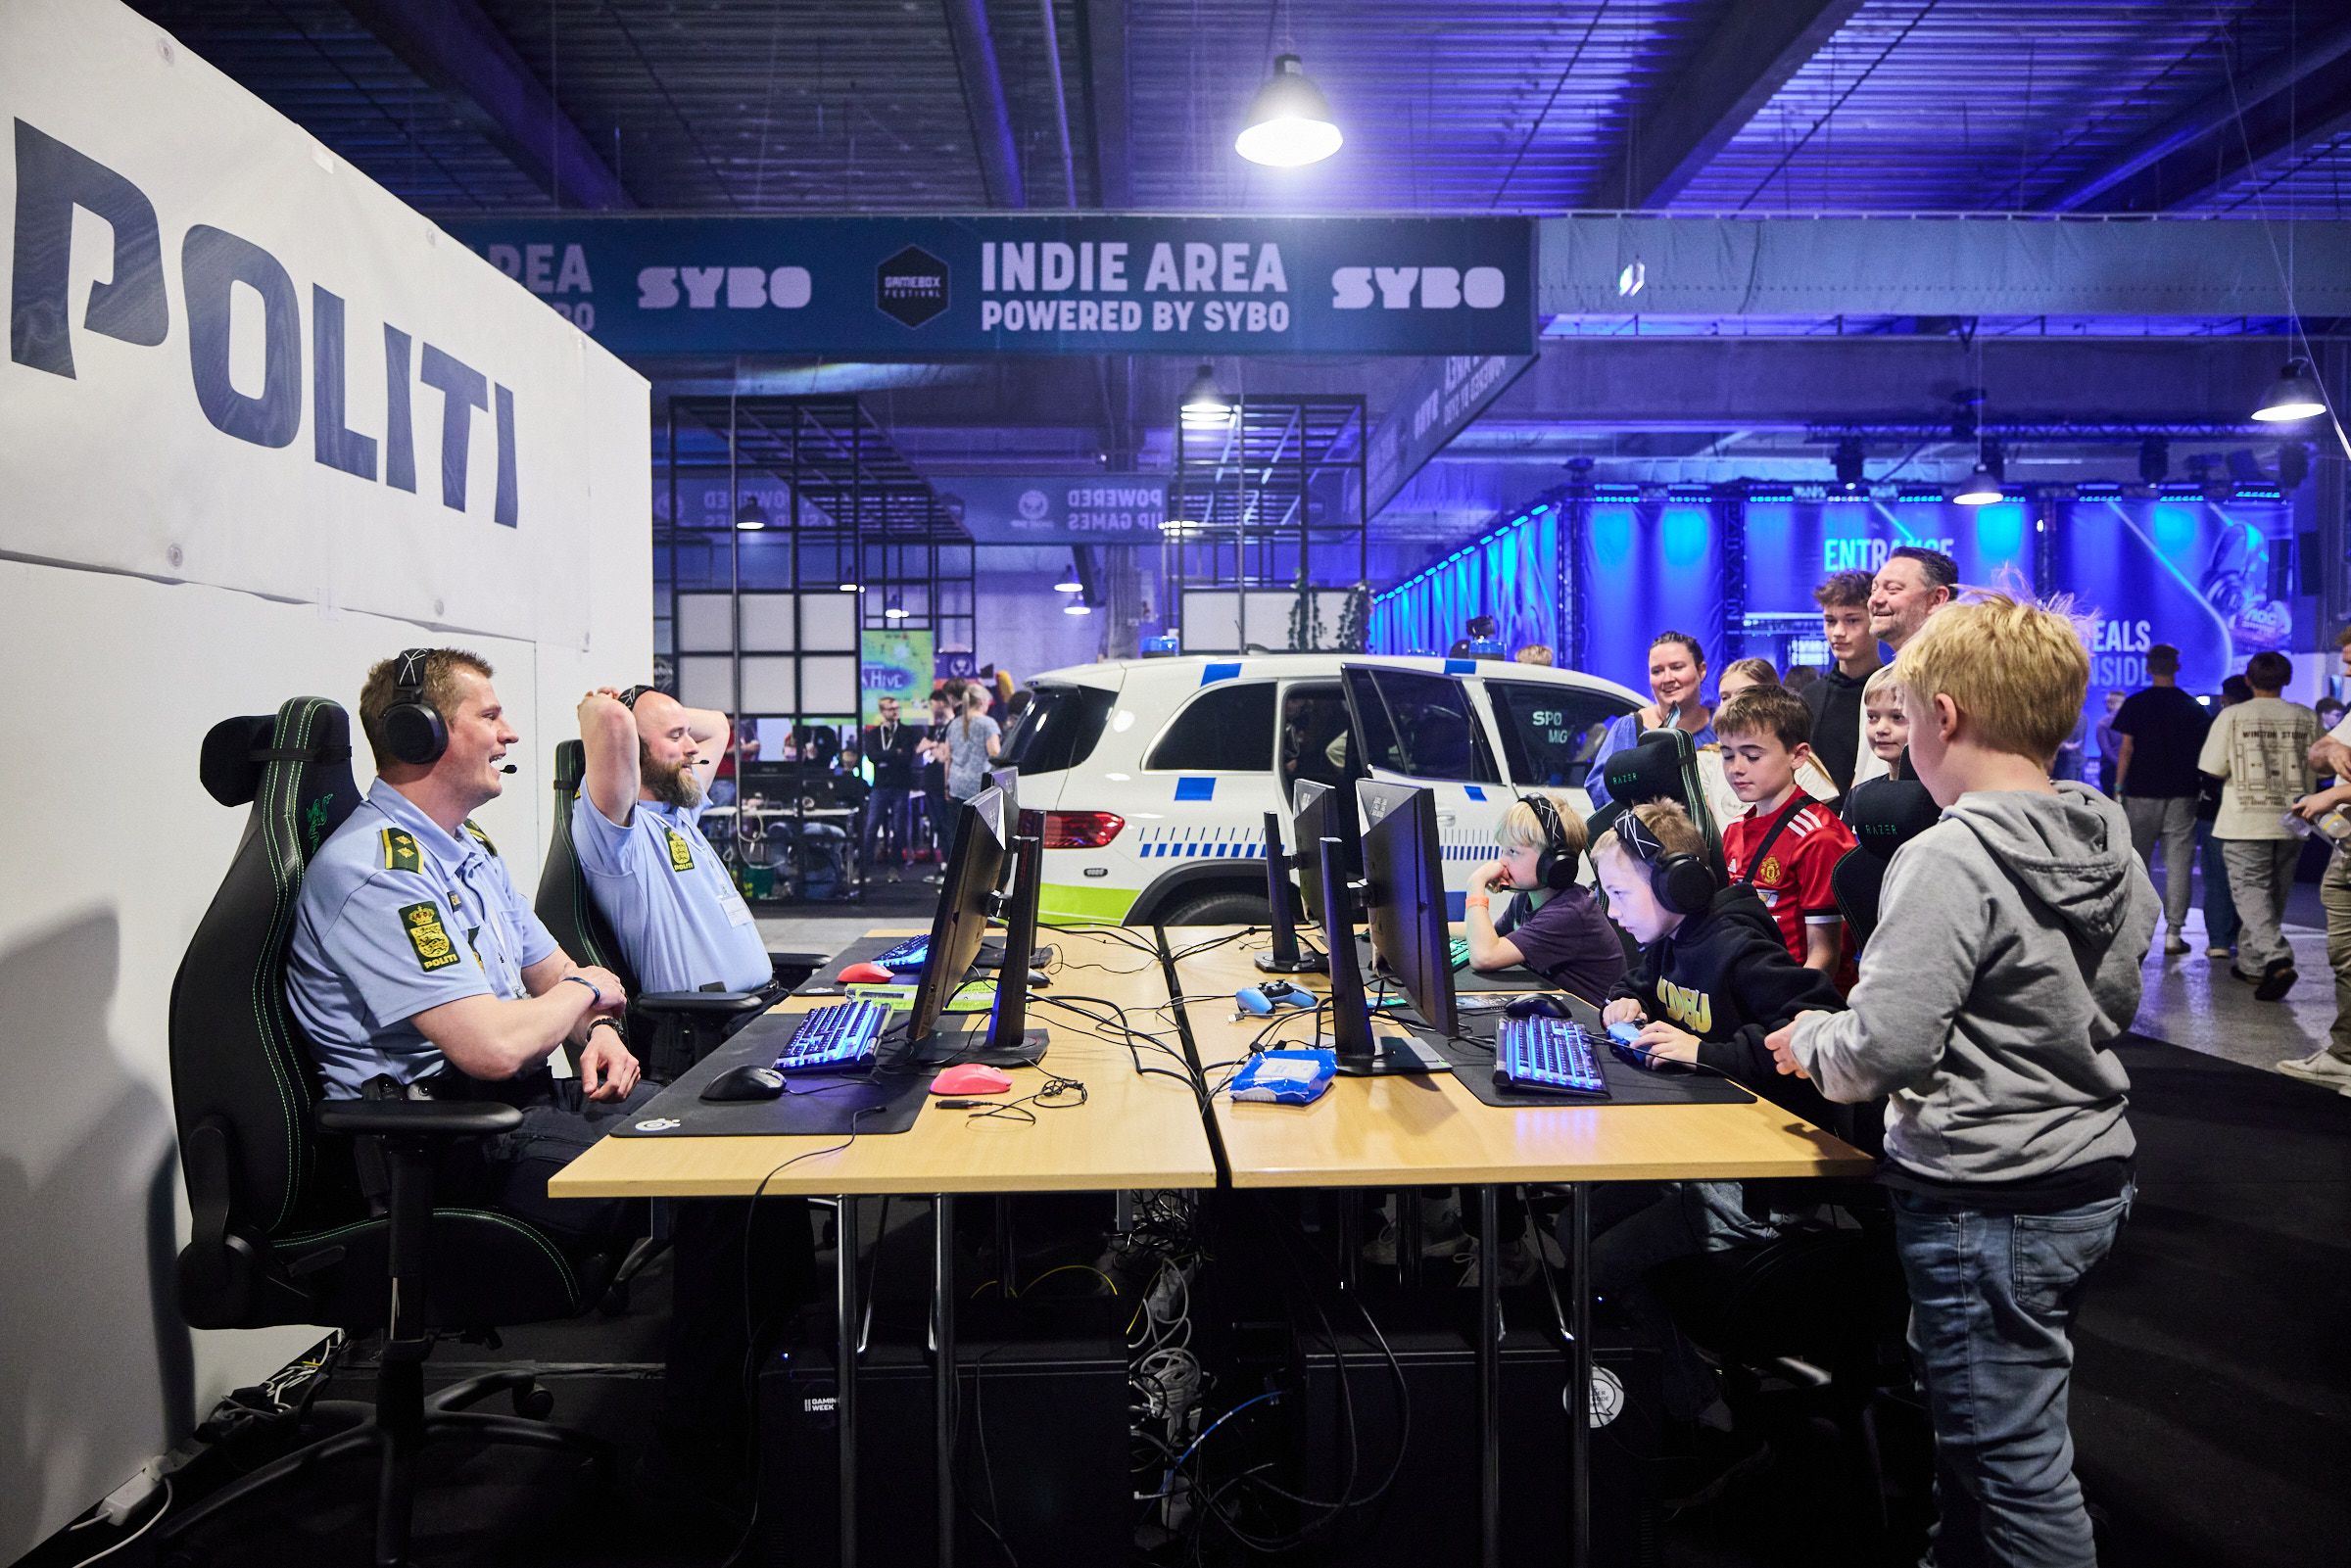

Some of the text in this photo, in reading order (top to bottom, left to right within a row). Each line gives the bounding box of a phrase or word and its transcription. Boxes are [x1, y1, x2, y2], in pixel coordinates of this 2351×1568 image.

[488, 244, 593, 293] REA
[638, 266, 811, 309] SYBO
[982, 243, 1288, 291] INDIE AREA
[1332, 266, 1505, 309] SYBO
[11, 116, 519, 529] POLITI
[983, 301, 1290, 331] POWERED BY SYBO
[2093, 619, 2151, 653] EALS
[1865, 824, 1897, 835] RAZER
[423, 953, 458, 969] POLITI
